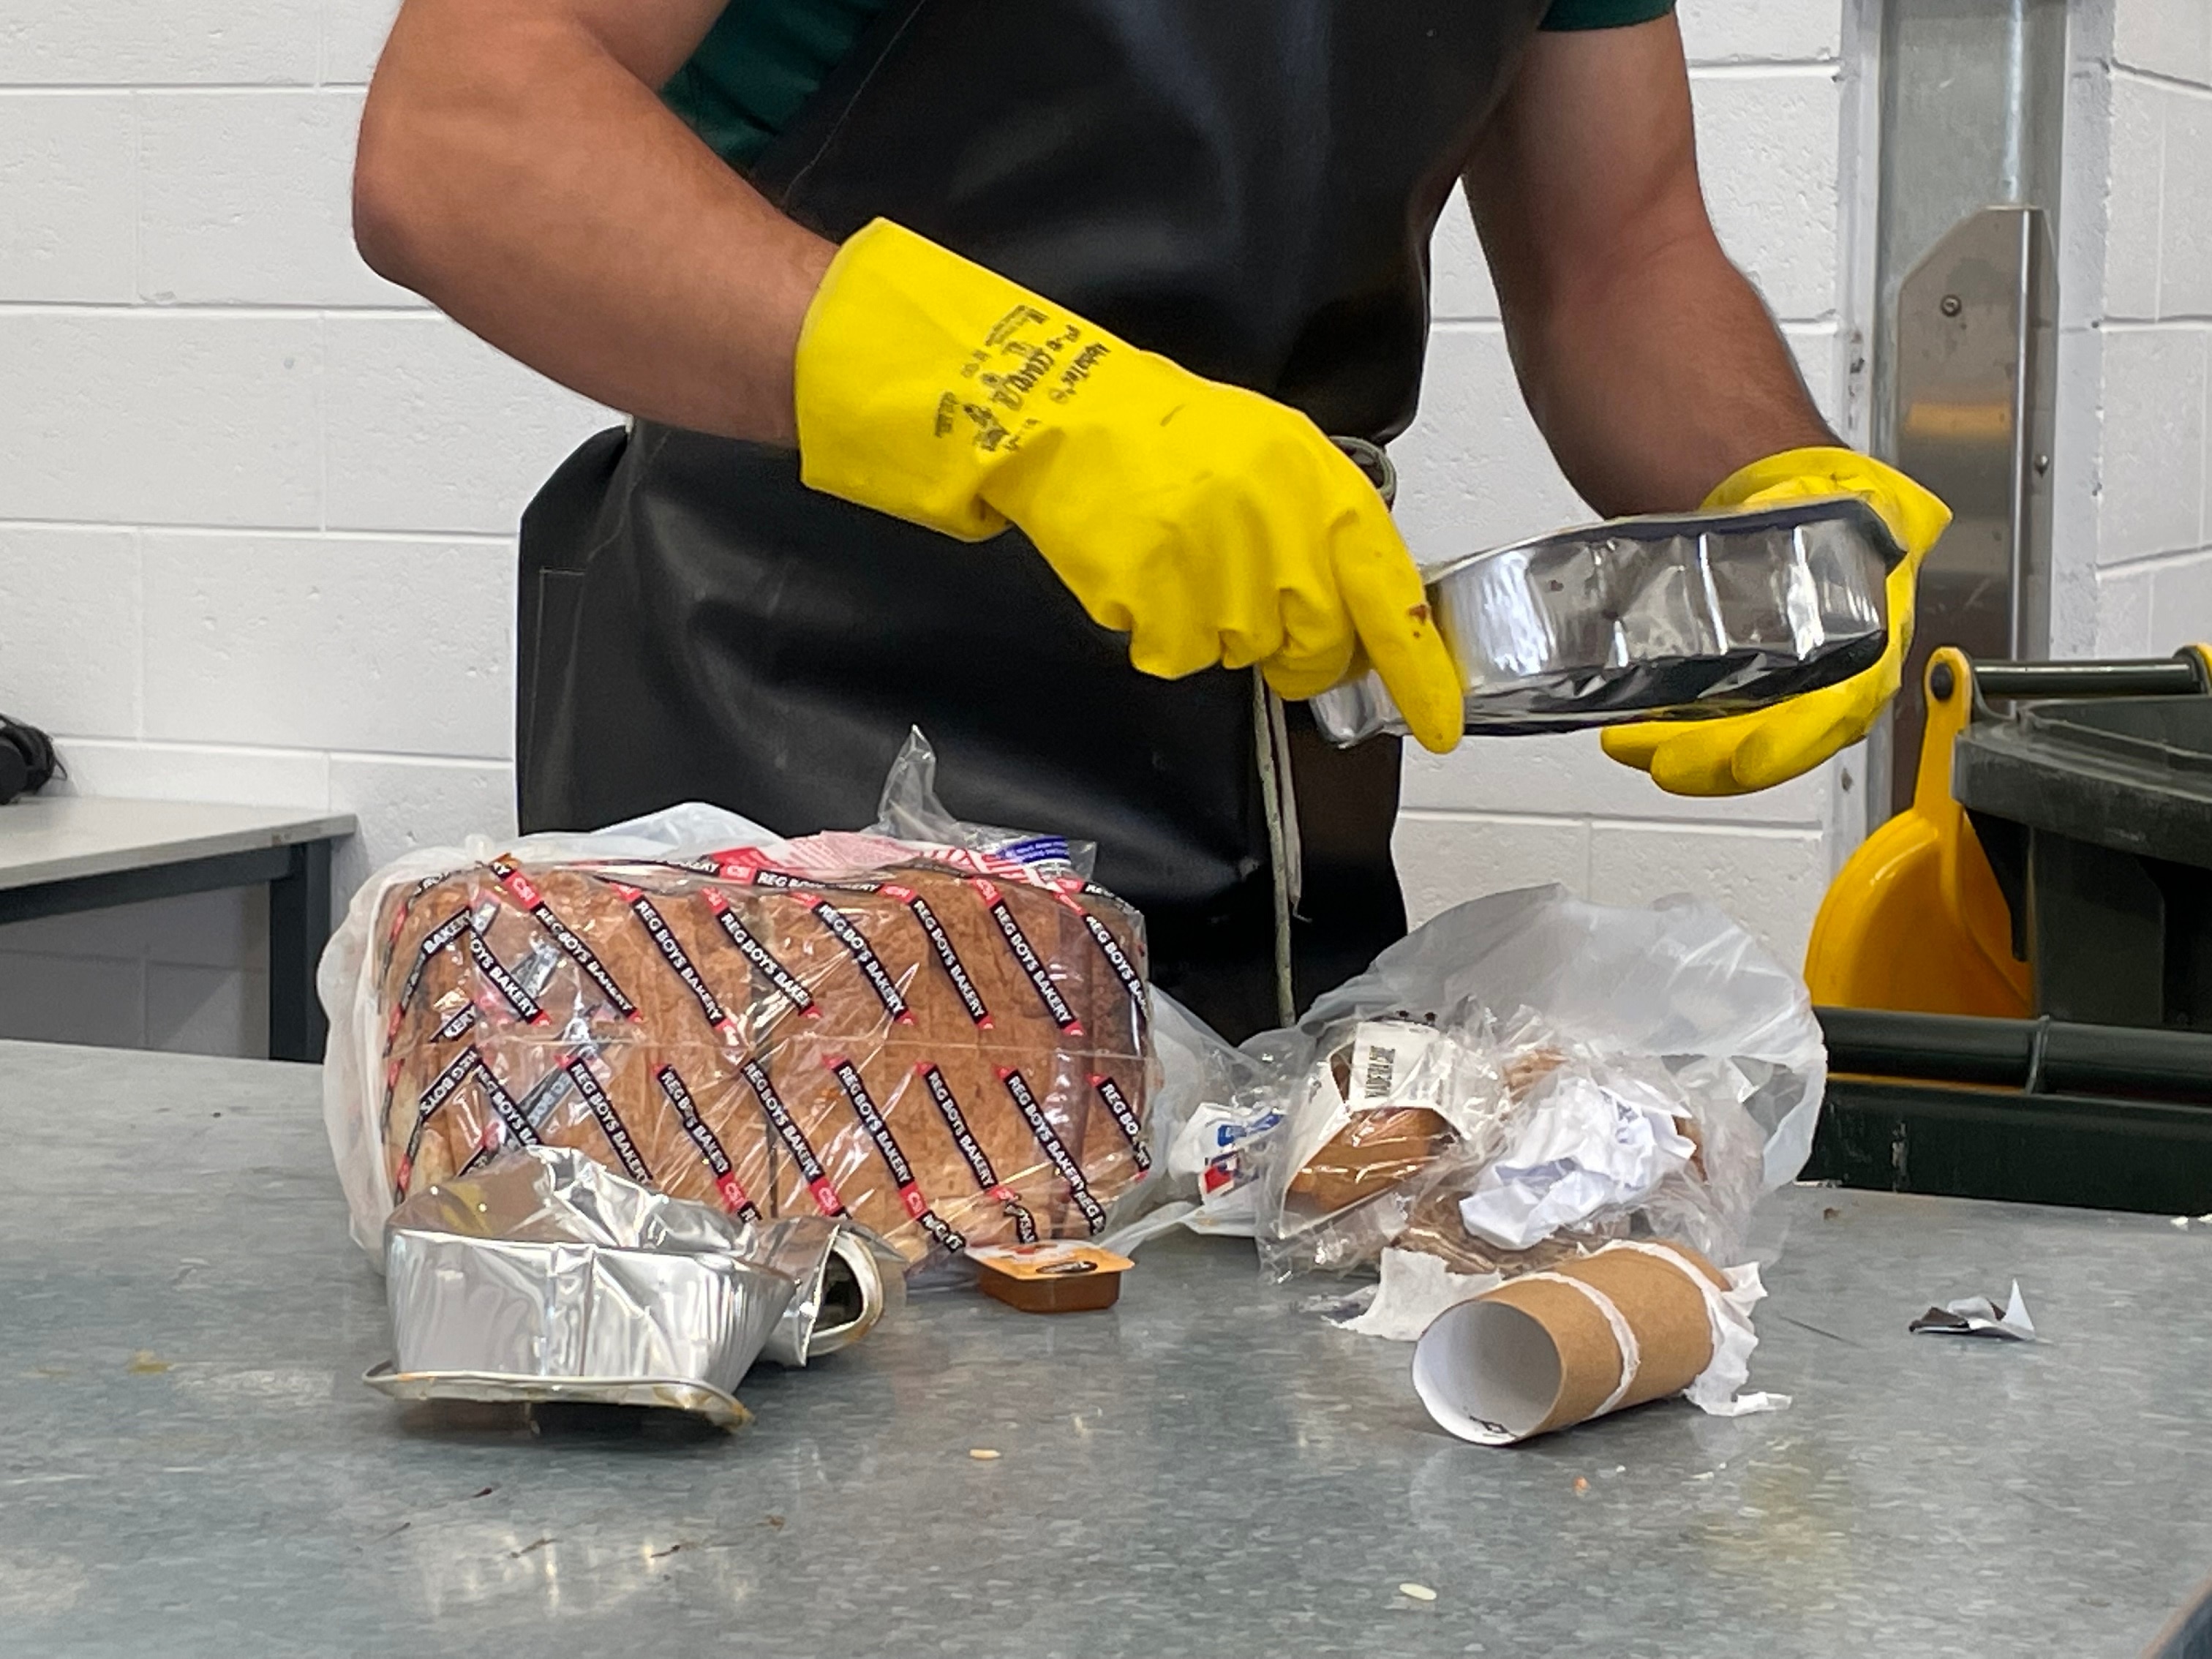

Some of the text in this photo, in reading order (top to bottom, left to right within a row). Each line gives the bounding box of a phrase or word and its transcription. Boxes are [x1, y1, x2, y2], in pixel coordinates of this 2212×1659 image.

[757, 871, 788, 887] REG
[557, 931, 592, 963] BOYS
[636, 900, 723, 1020] REG BOYS BAKERY
[721, 912, 748, 944] REG
[741, 938, 778, 975] BOYS
[914, 900, 986, 1017] REG BOYS BAKERY
[994, 905, 1017, 936] REG
[1010, 932, 1039, 972] BOYS
[1032, 969, 1072, 1023] BAKERY
[1086, 915, 1112, 944] REG
[1103, 941, 1135, 981] BOYS
[489, 966, 539, 1017] BAKERY
[865, 960, 906, 1014] BAKERY
[571, 1062, 598, 1096] REG
[589, 1091, 621, 1132] BOYS
[661, 1071, 685, 1101] REG
[743, 1062, 770, 1092] REG
[760, 1087, 790, 1127] BOYS
[781, 1124, 822, 1178] BAKERY
[1100, 1083, 1127, 1116] REG
[838, 1065, 862, 1096] REG
[853, 1093, 884, 1132] BOYS
[876, 1130, 912, 1184] BAKERY
[928, 1071, 996, 1187] REG BOYS BAKERY
[1007, 1075, 1032, 1107] REG
[1023, 1102, 1055, 1143] BOYS
[1045, 1139, 1086, 1192] BAKERY
